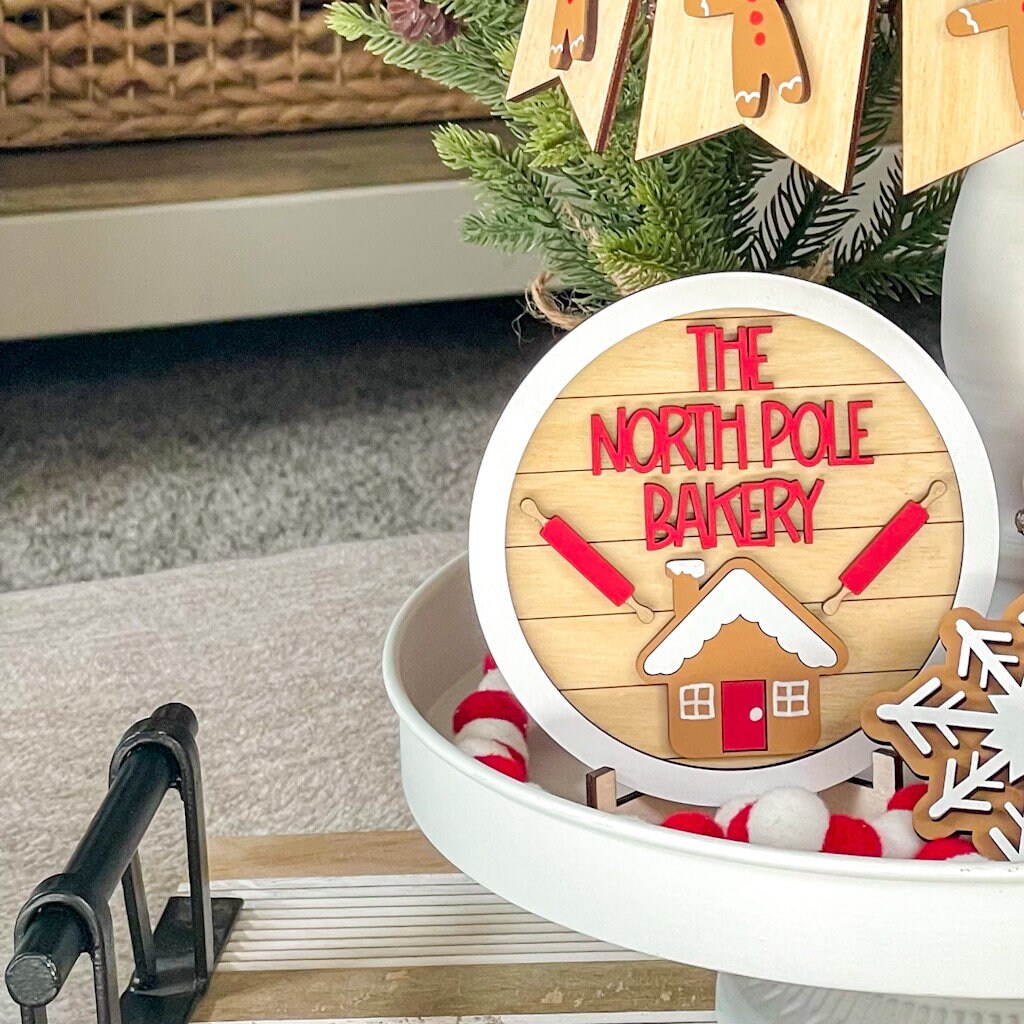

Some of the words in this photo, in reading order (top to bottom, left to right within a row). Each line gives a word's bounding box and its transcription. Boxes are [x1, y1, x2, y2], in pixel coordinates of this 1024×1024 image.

[686, 325, 774, 392] THE
[591, 404, 748, 476] NORTH
[761, 400, 874, 468] POLE
[643, 478, 825, 551] BAKERY
